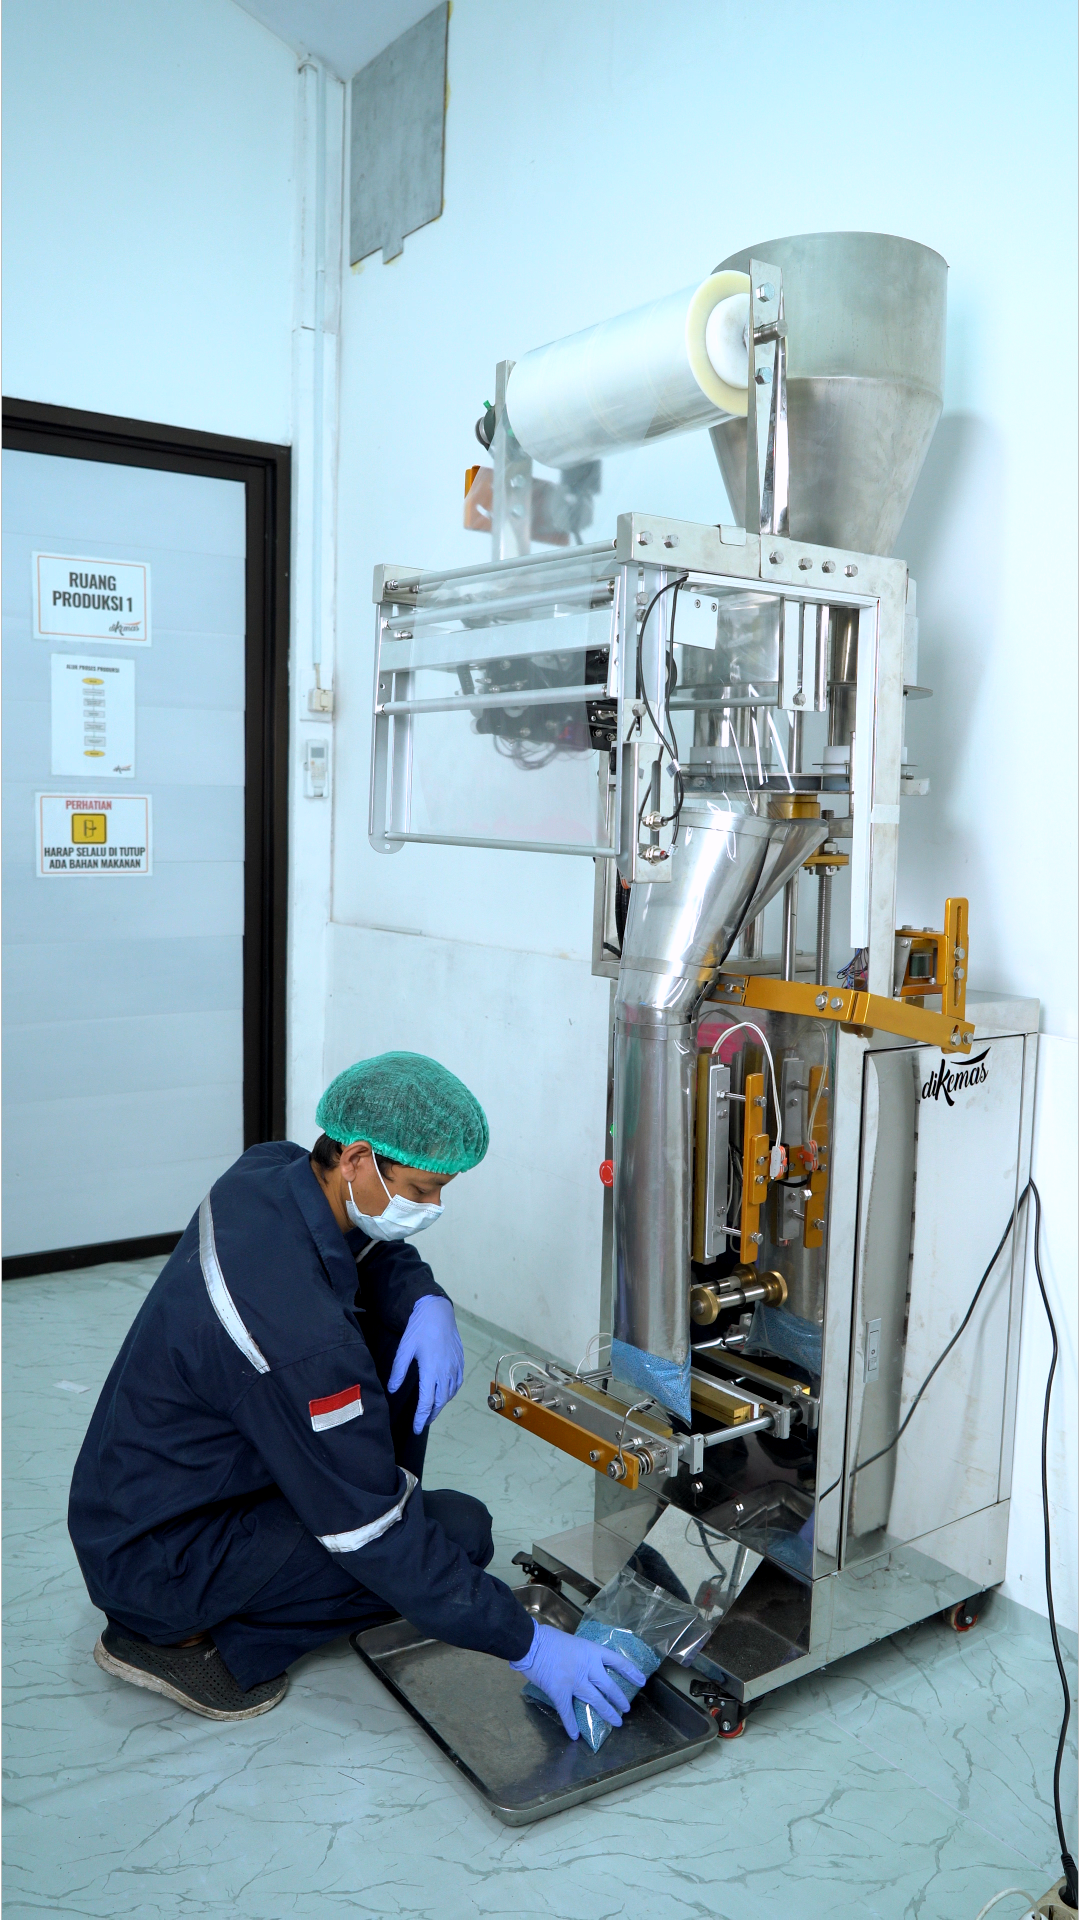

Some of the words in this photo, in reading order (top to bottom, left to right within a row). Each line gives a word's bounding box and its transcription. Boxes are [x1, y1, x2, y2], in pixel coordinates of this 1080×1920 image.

[69, 571, 117, 591] RUANG
[52, 590, 123, 612] PRODUKSI
[126, 597, 132, 612] 1
[65, 800, 112, 810] PERHATIAN
[44, 847, 74, 857] HARAP
[76, 847, 107, 857] SELALU
[108, 847, 117, 857] DI
[119, 847, 146, 857] TUTUP
[49, 859, 67, 869] ADA
[69, 859, 98, 869] BAHAN
[100, 859, 141, 868] MAKANAN
